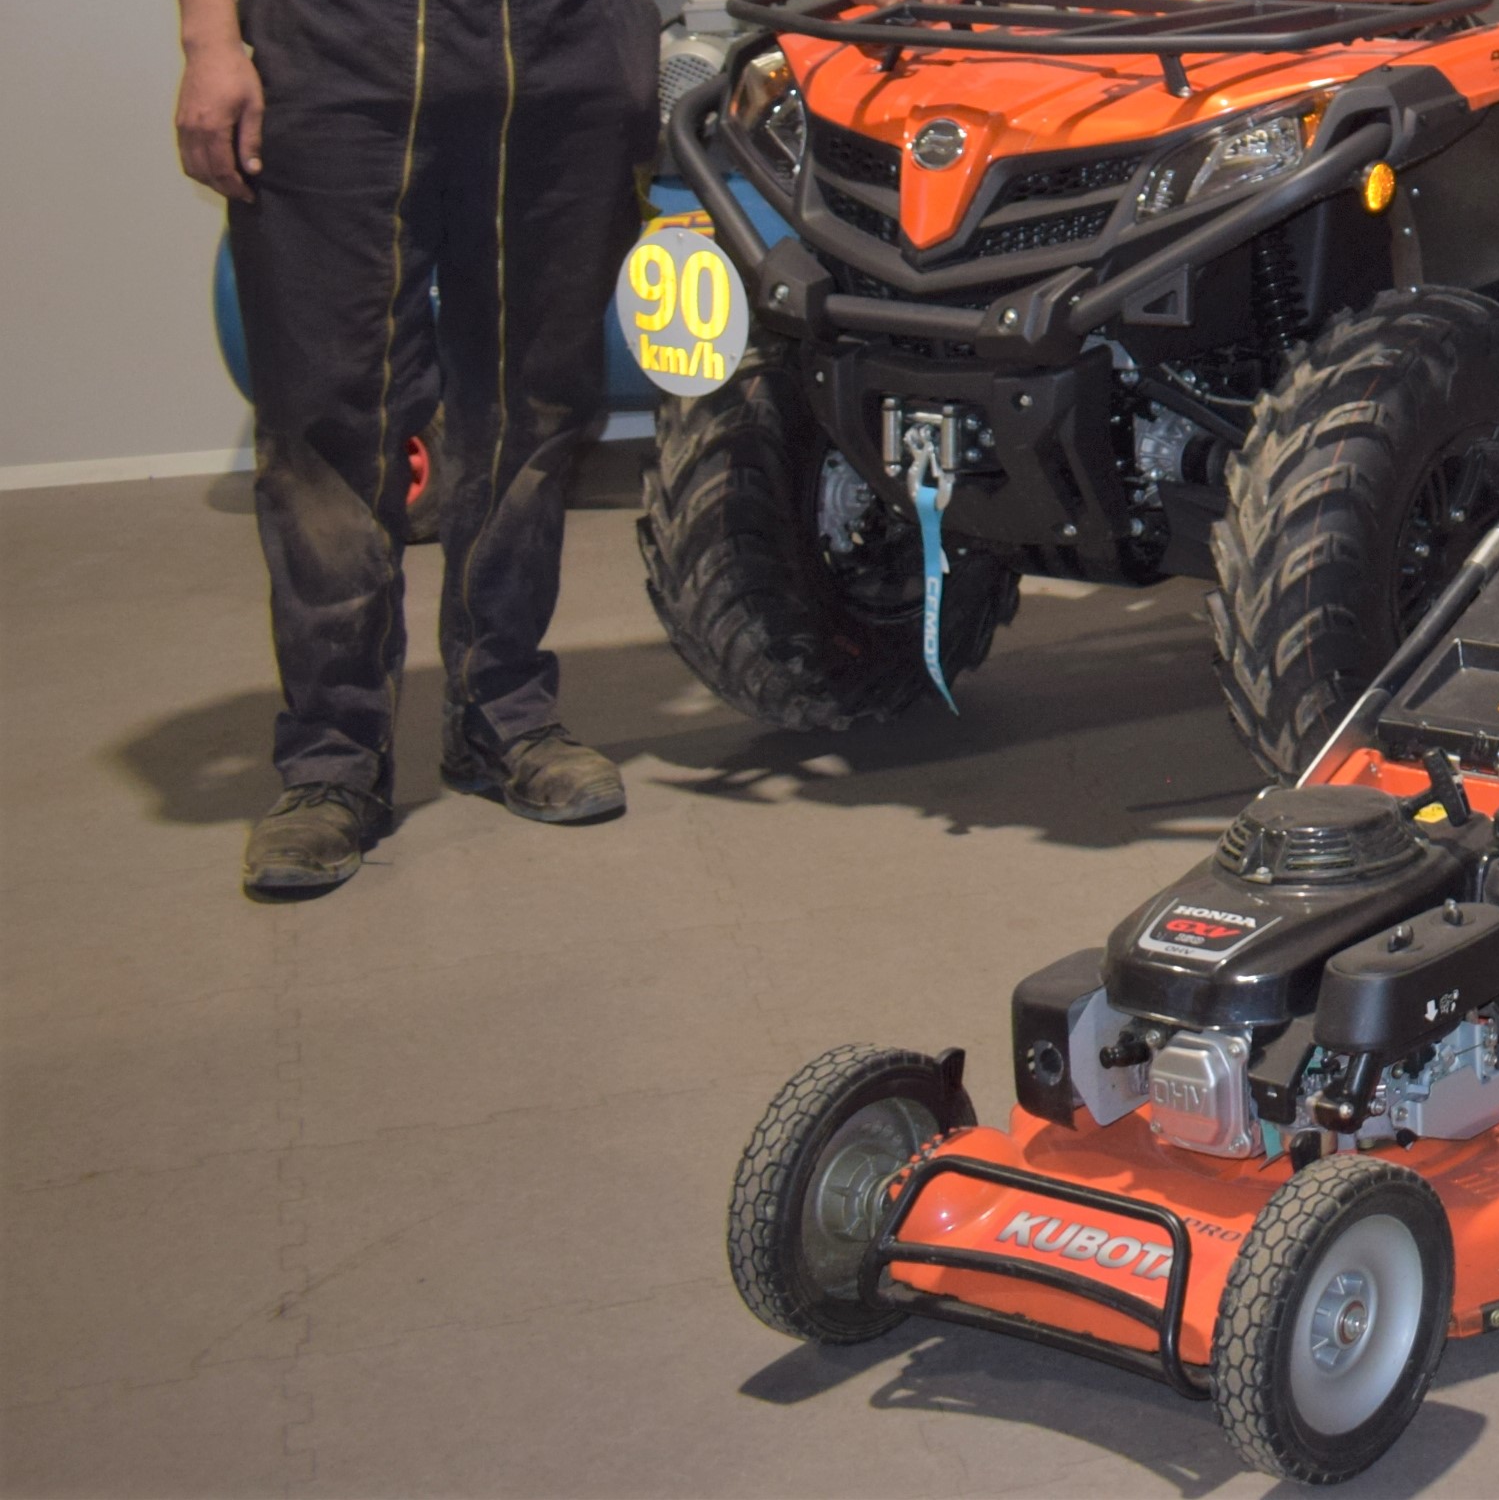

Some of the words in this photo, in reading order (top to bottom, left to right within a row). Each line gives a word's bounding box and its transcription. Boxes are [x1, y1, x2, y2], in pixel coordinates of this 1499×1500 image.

[628, 244, 730, 340] 90
[640, 334, 725, 381] km/h
[1165, 918, 1242, 938] GXV
[1173, 905, 1257, 929] HONDA
